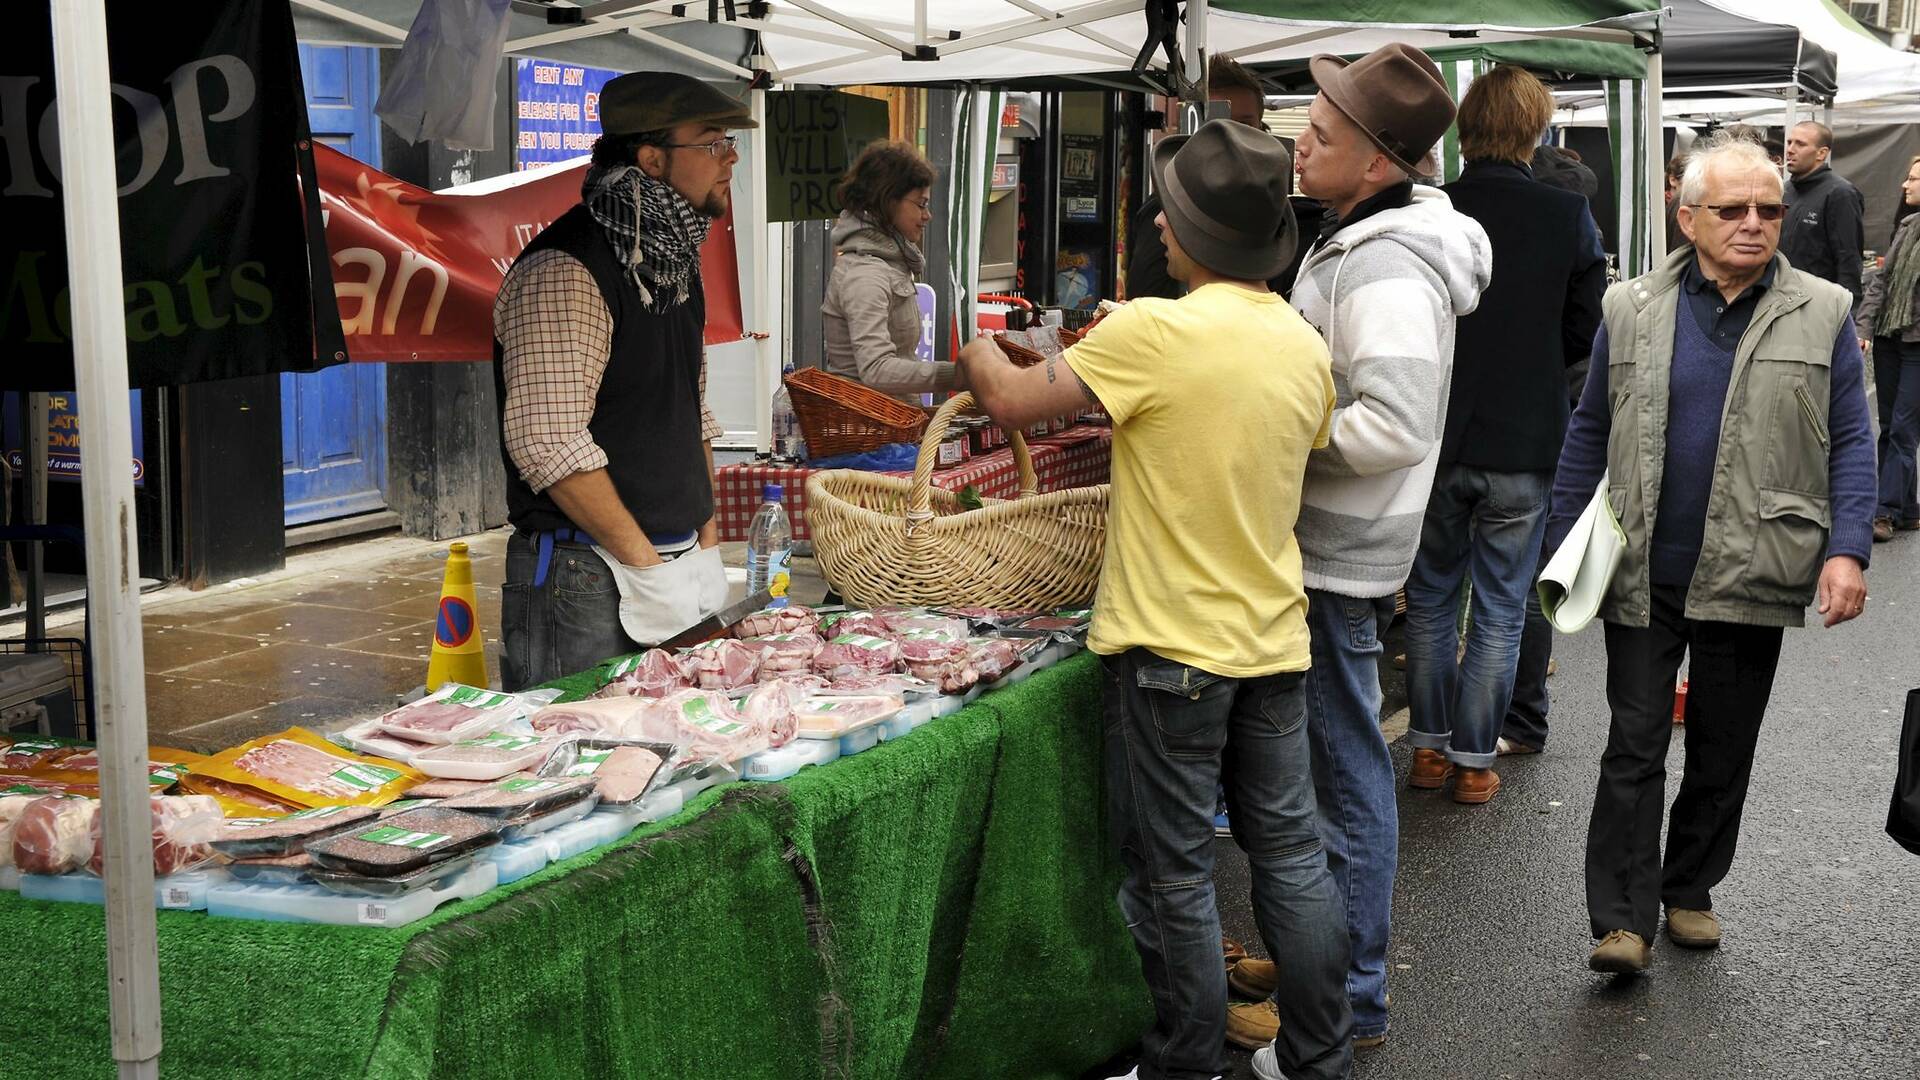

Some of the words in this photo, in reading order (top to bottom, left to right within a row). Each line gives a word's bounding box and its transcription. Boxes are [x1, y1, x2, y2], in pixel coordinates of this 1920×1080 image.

[534, 66, 560, 84] RENT
[563, 68, 584, 86] ANY
[518, 101, 557, 120] ELEASE
[559, 103, 579, 120] FOR
[539, 132, 560, 149] YOU
